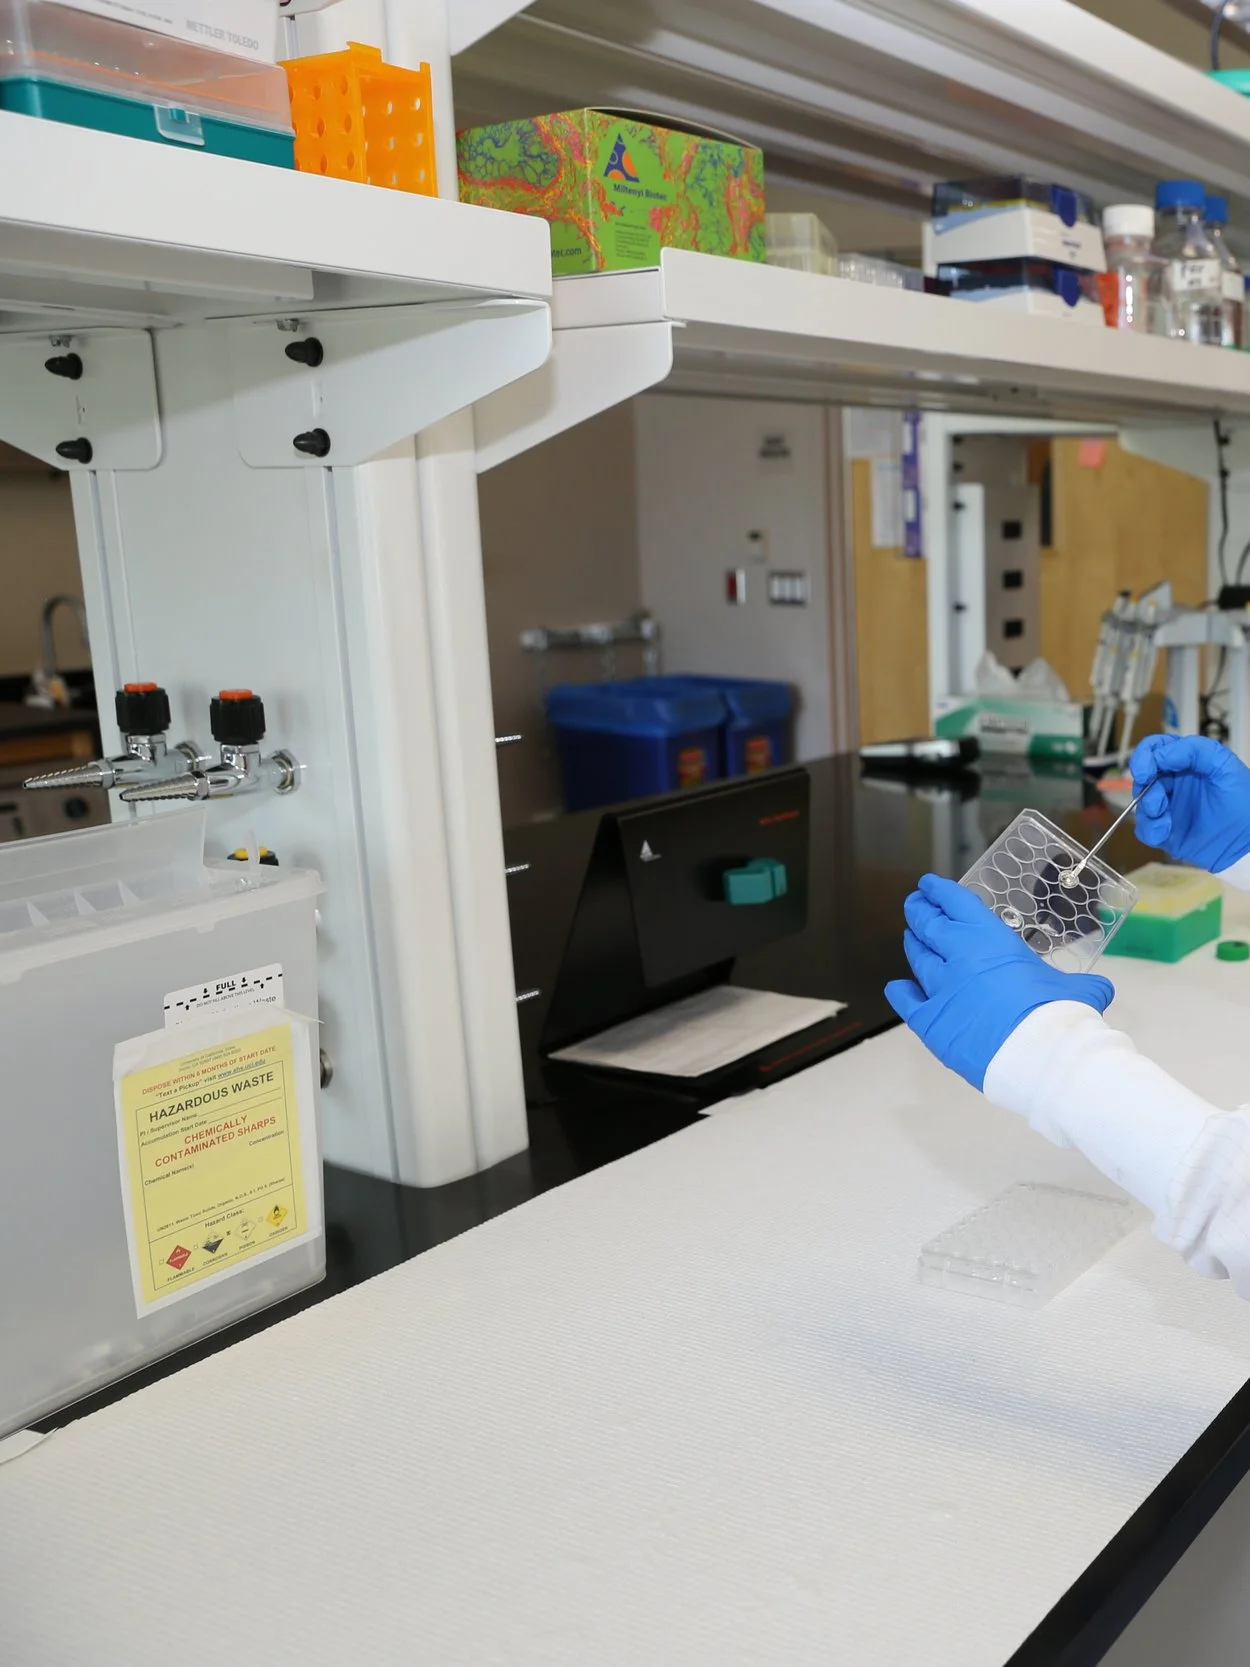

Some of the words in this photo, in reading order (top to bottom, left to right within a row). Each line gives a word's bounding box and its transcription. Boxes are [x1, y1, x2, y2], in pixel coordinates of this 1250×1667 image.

[186, 19, 226, 40] METTLER
[227, 32, 259, 50] TOLEDO
[613, 183, 644, 198] Miltenyi
[645, 189, 668, 200] Biotec
[216, 980, 236, 990] FULL
[142, 1080, 170, 1094] DISPOSE
[172, 1072, 195, 1084] WITHIN
[201, 1061, 228, 1074] MONTHS
[238, 1051, 258, 1062] START
[259, 1045, 275, 1055] DATE
[204, 1074, 216, 1082] visit
[149, 1086, 228, 1122] HAZARDOUS
[231, 1070, 273, 1094] WASTE
[140, 1129, 179, 1147] Accumulation
[180, 1124, 193, 1132] Start
[194, 1119, 207, 1127] Date
[150, 1118, 180, 1134] Supervisor
[181, 1112, 197, 1121] Name
[184, 1114, 247, 1144] CHEMICALLY
[154, 1130, 234, 1167] CONTAMINATED
[237, 1115, 275, 1137] SHARPS
[249, 1128, 284, 1146] Concentration
[144, 1172, 170, 1186] Chemical
[171, 1162, 194, 1176] Name(s)
[204, 1215, 225, 1228] Hazard
[226, 1207, 244, 1219] Class:
